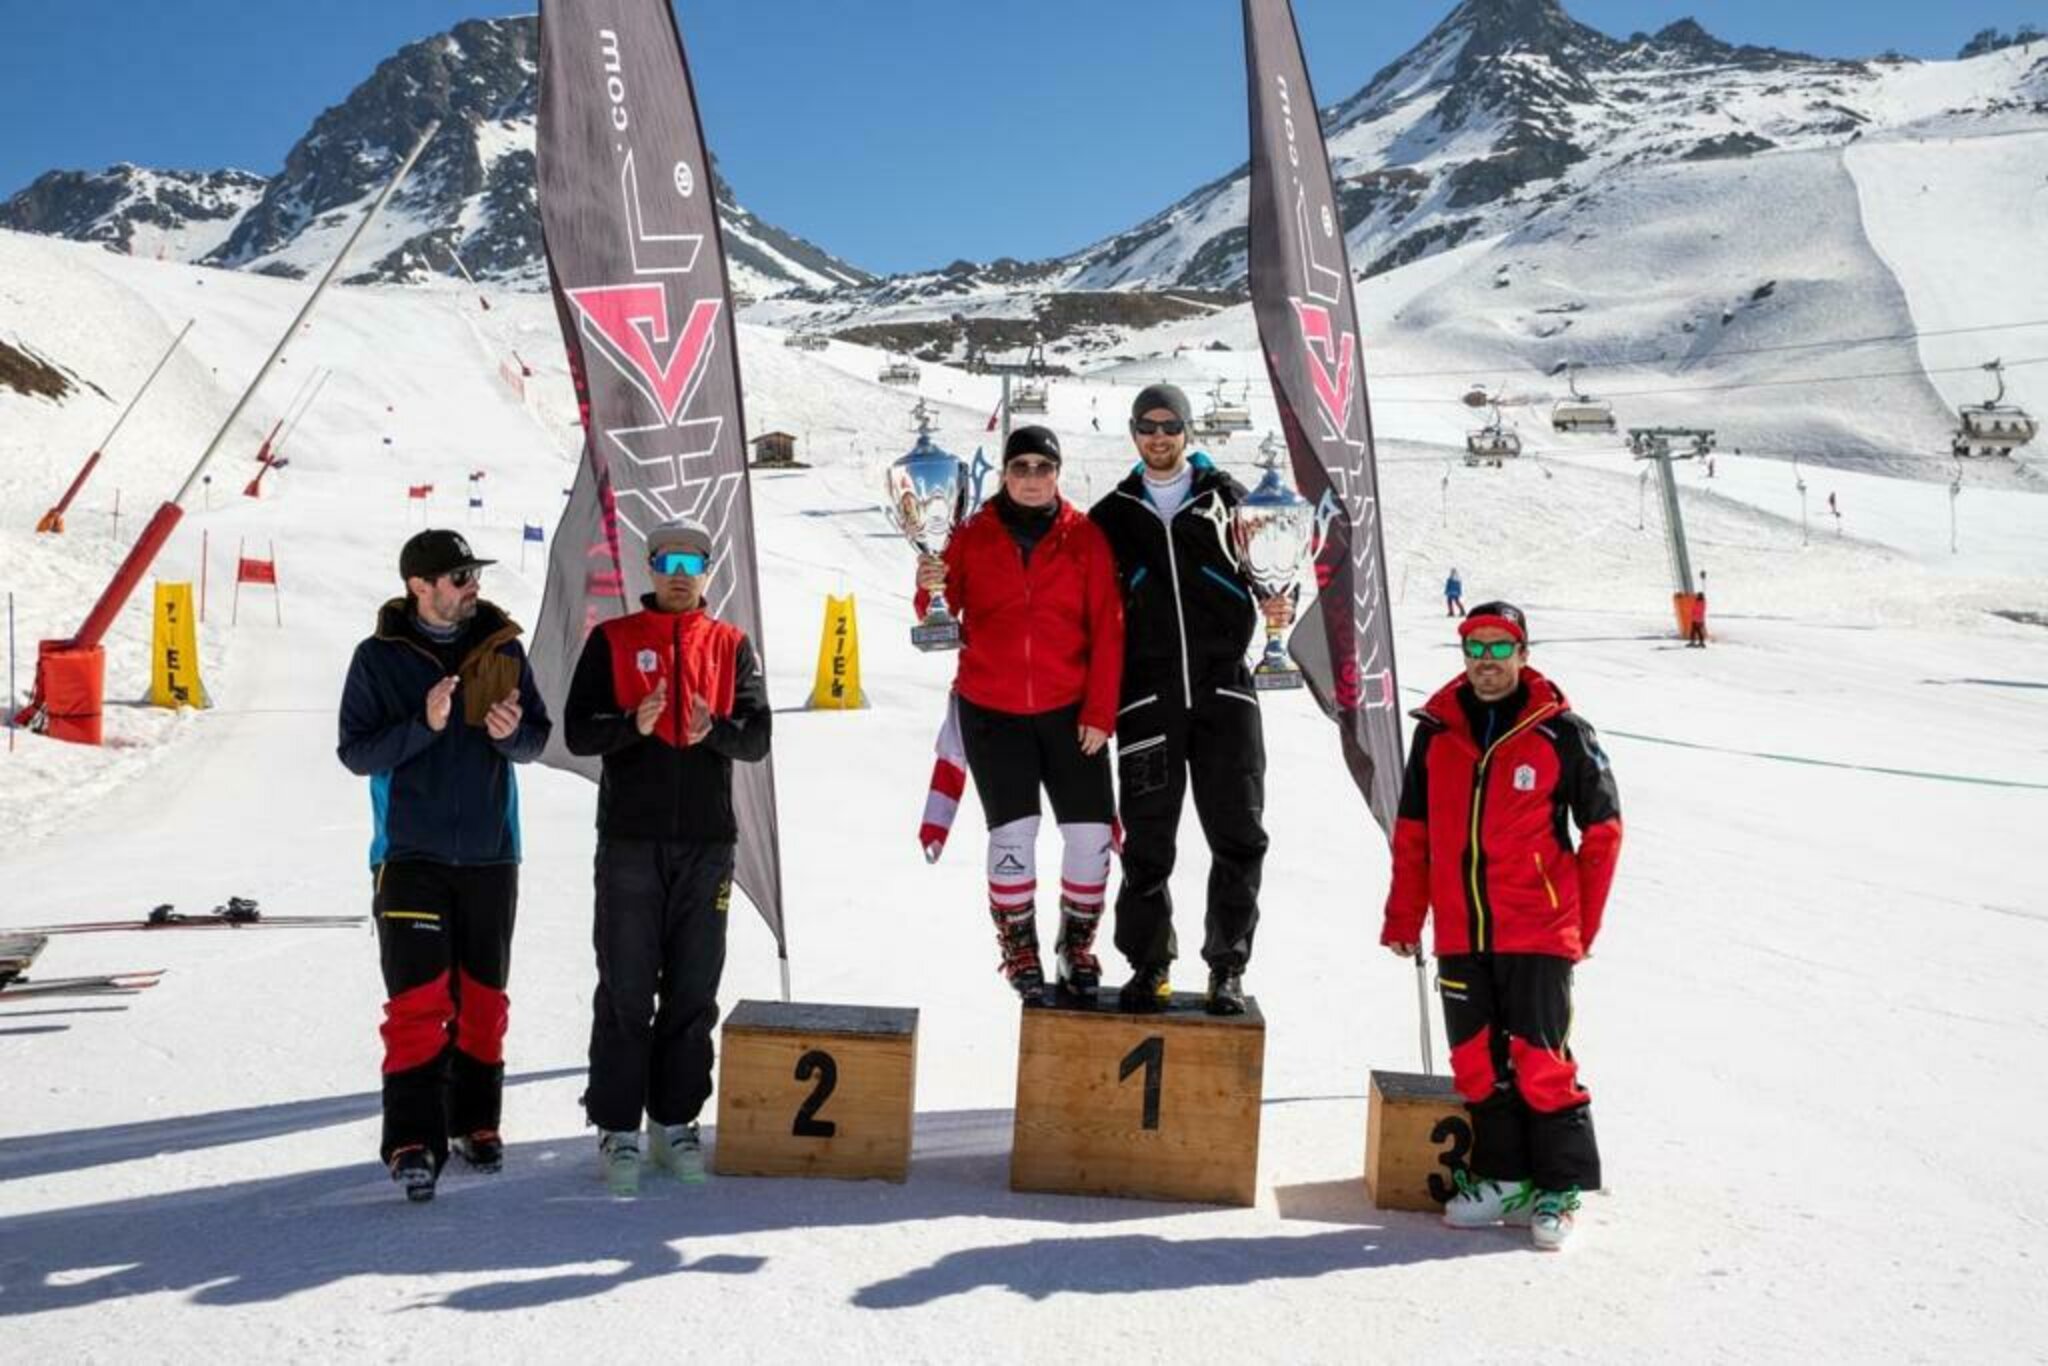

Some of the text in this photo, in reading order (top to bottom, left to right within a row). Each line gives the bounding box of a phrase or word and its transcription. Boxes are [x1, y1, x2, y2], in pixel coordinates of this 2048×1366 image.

[792, 1049, 838, 1138] 2
[1119, 1037, 1165, 1131] 1
[1427, 1115, 1475, 1204] 3
